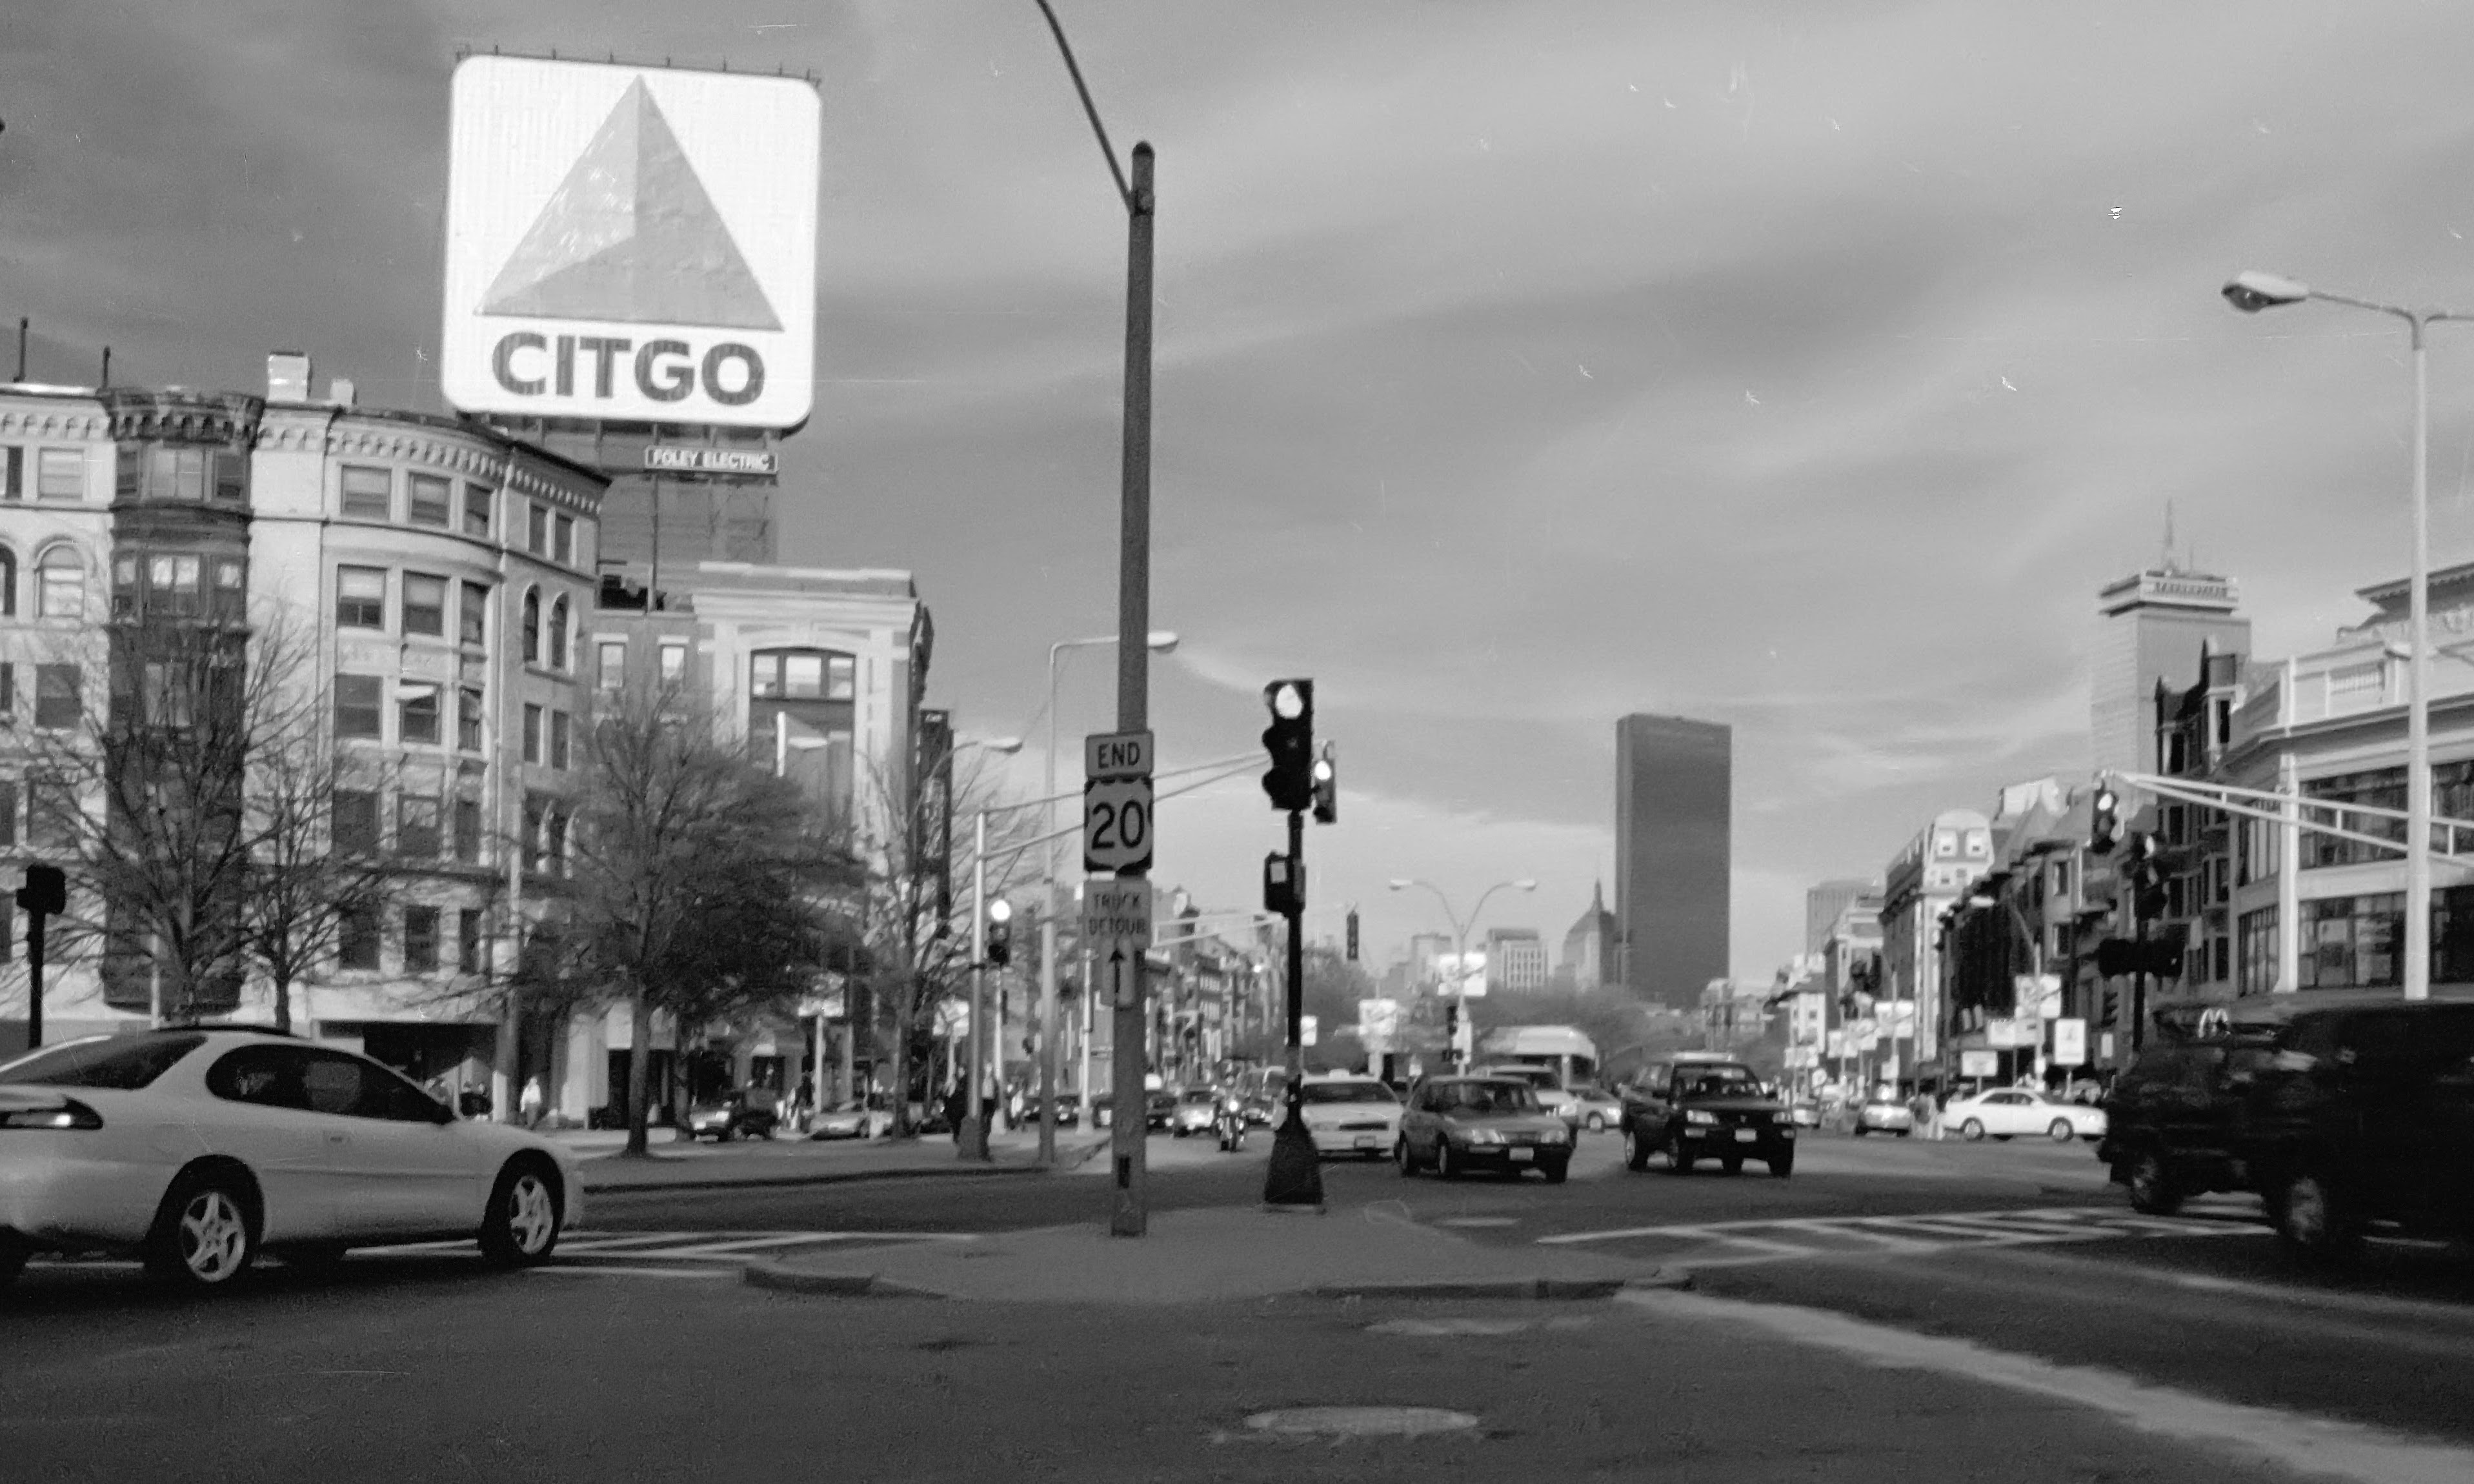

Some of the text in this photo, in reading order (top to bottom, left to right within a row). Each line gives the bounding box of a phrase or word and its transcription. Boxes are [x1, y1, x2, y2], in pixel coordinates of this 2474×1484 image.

[491, 332, 765, 406] CITGO
[653, 448, 770, 471] FOLEY ELECTRIC
[1098, 742, 1141, 769] END
[1091, 799, 1145, 850] 20
